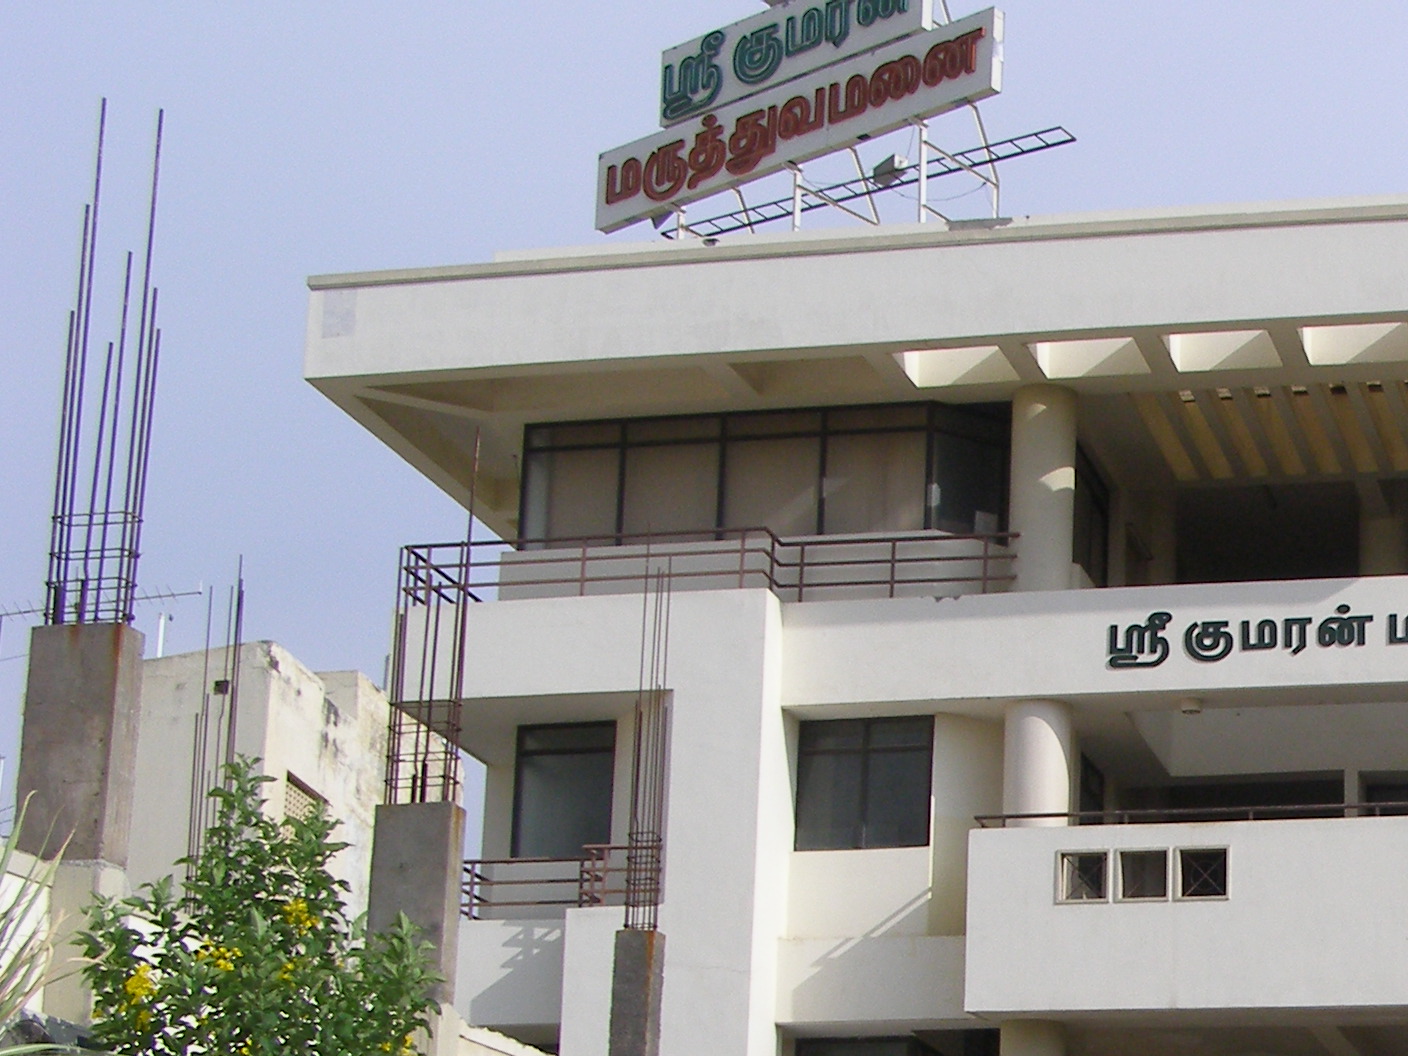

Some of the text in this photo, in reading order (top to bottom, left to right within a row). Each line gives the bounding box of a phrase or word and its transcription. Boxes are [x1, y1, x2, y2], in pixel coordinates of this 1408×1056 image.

[732, 0, 908, 85] குமரன
[605, 27, 986, 205] மருத்துவமனை
[1184, 604, 1374, 662] குமரன்
